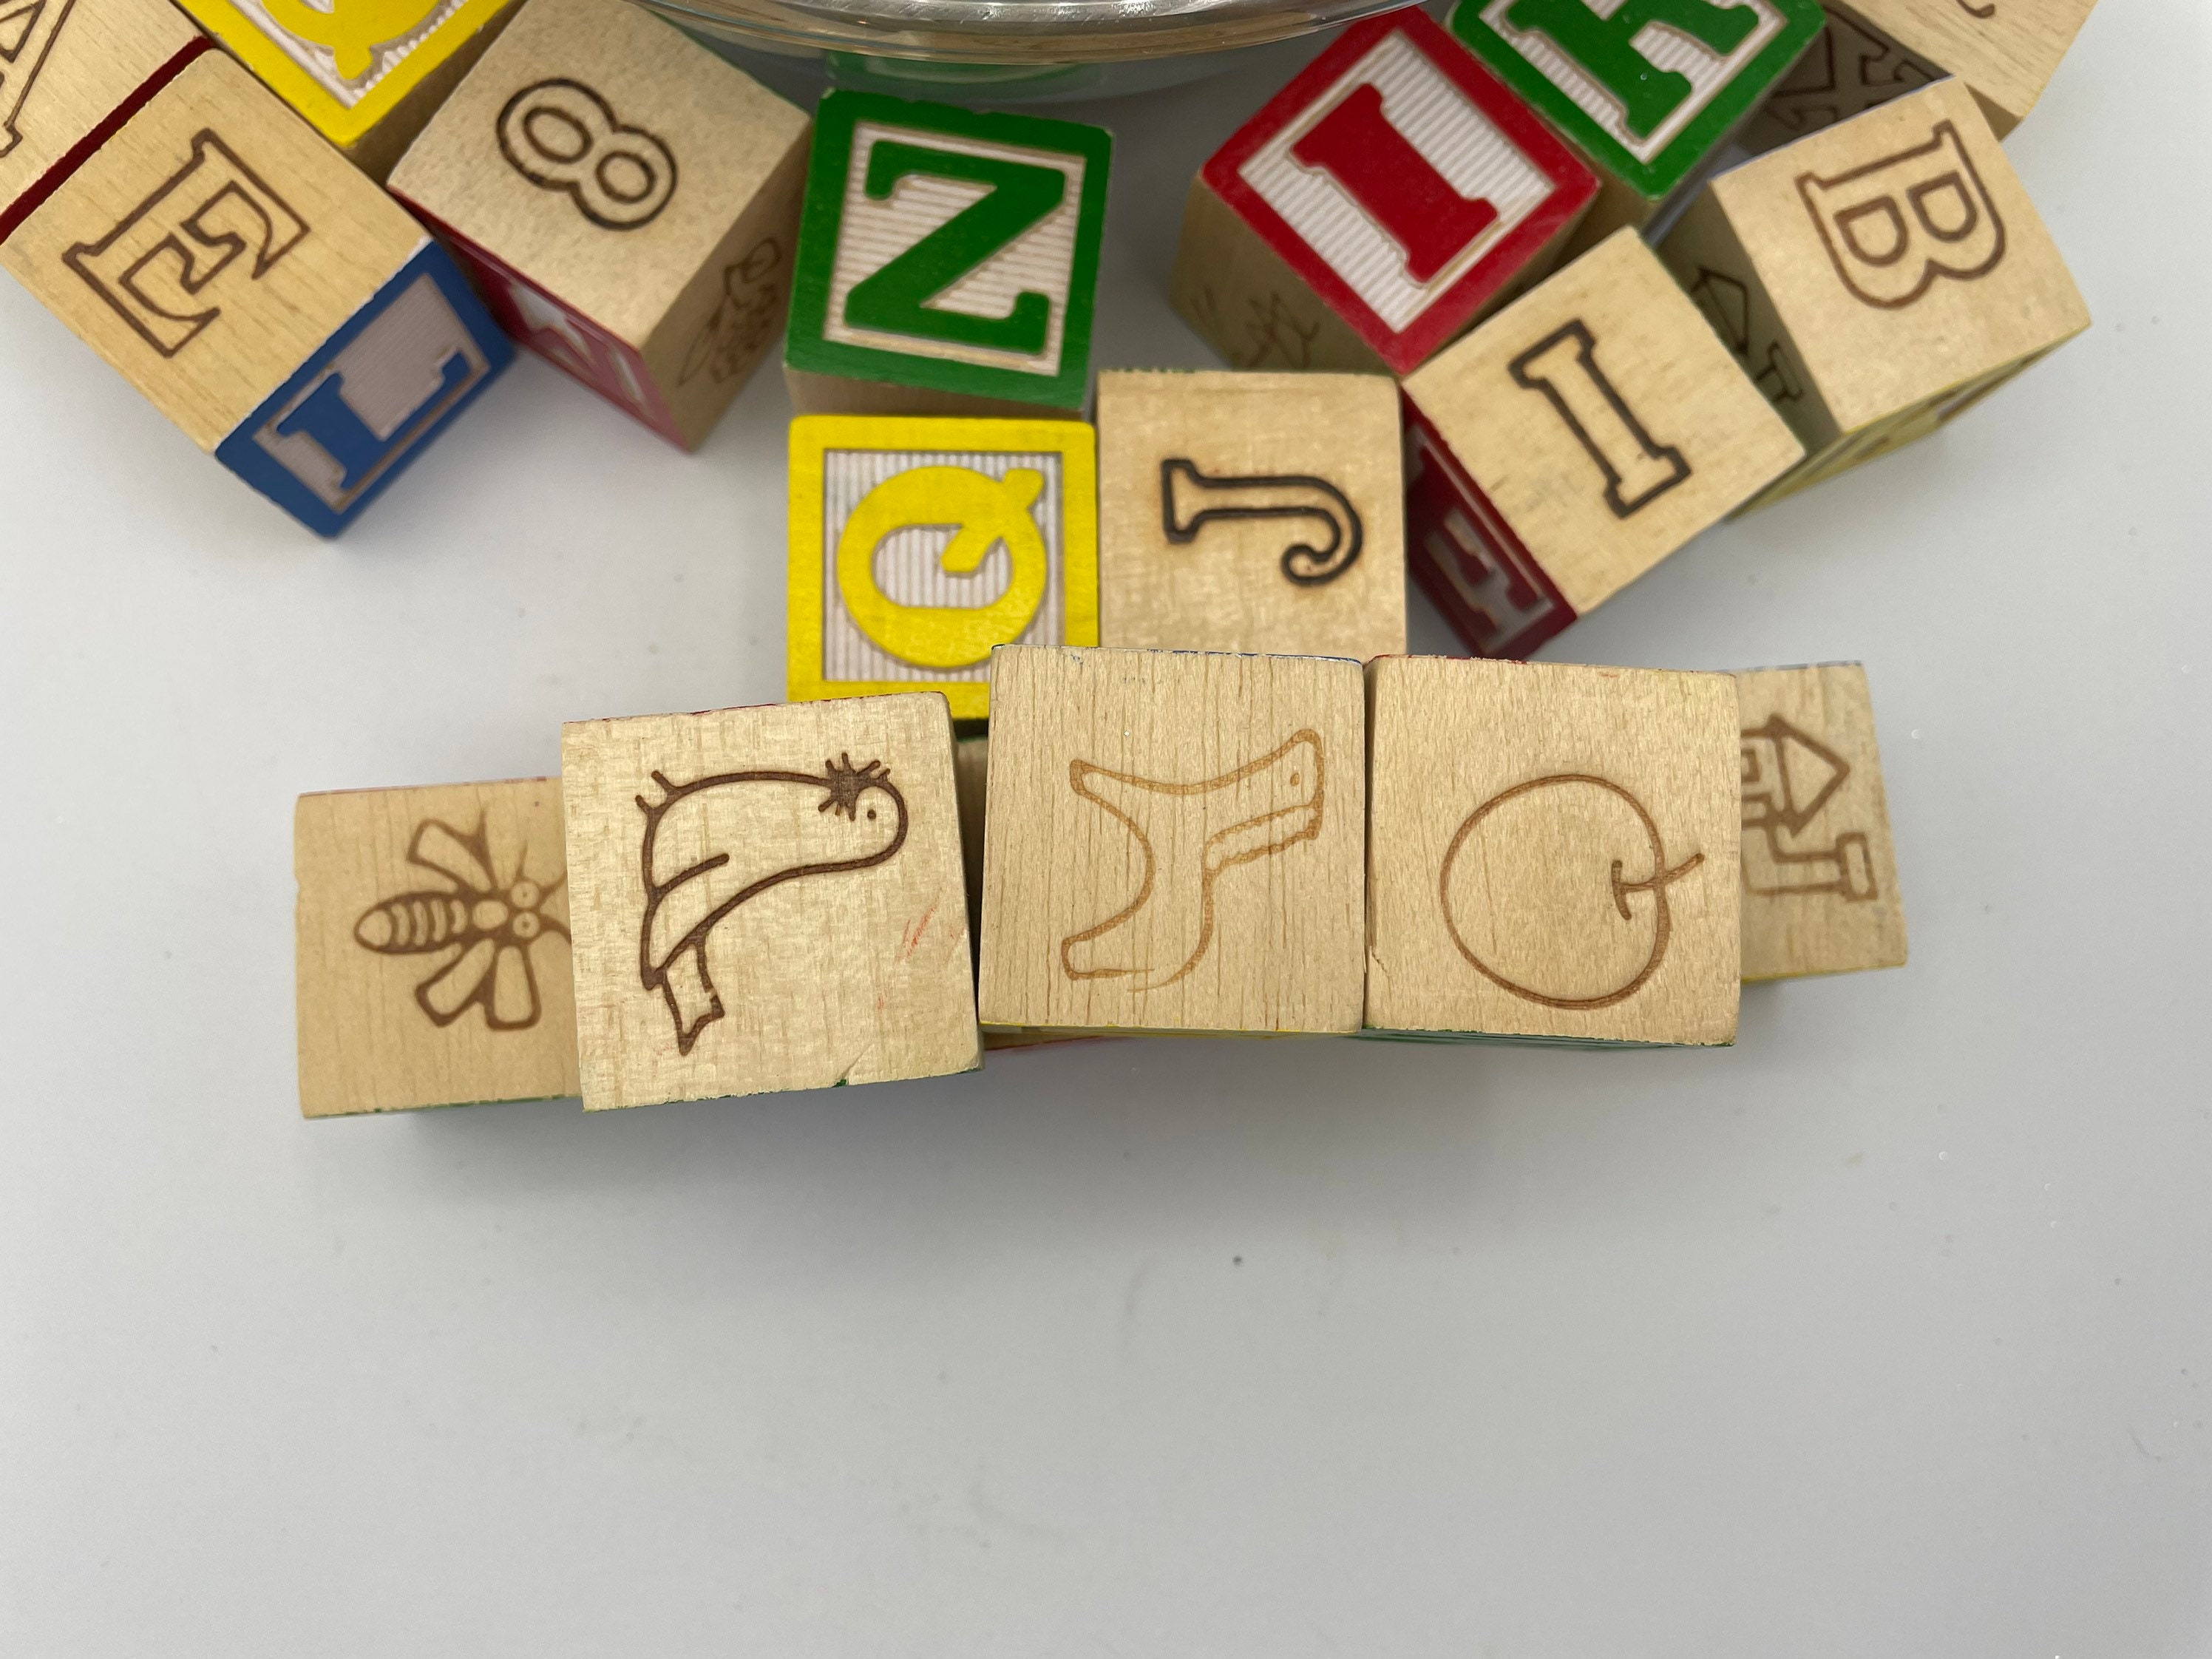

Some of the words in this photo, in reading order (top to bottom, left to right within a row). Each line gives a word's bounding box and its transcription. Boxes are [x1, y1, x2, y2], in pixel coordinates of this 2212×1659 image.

[61, 126, 311, 359] E
[495, 77, 679, 231] 8
[843, 140, 1065, 355] Z
[1290, 82, 1498, 284] I
[1793, 118, 2007, 311] B
[276, 350, 474, 489] L
[1507, 318, 1692, 520] I
[836, 465, 1048, 668] Q
[1161, 457, 1363, 587] J
